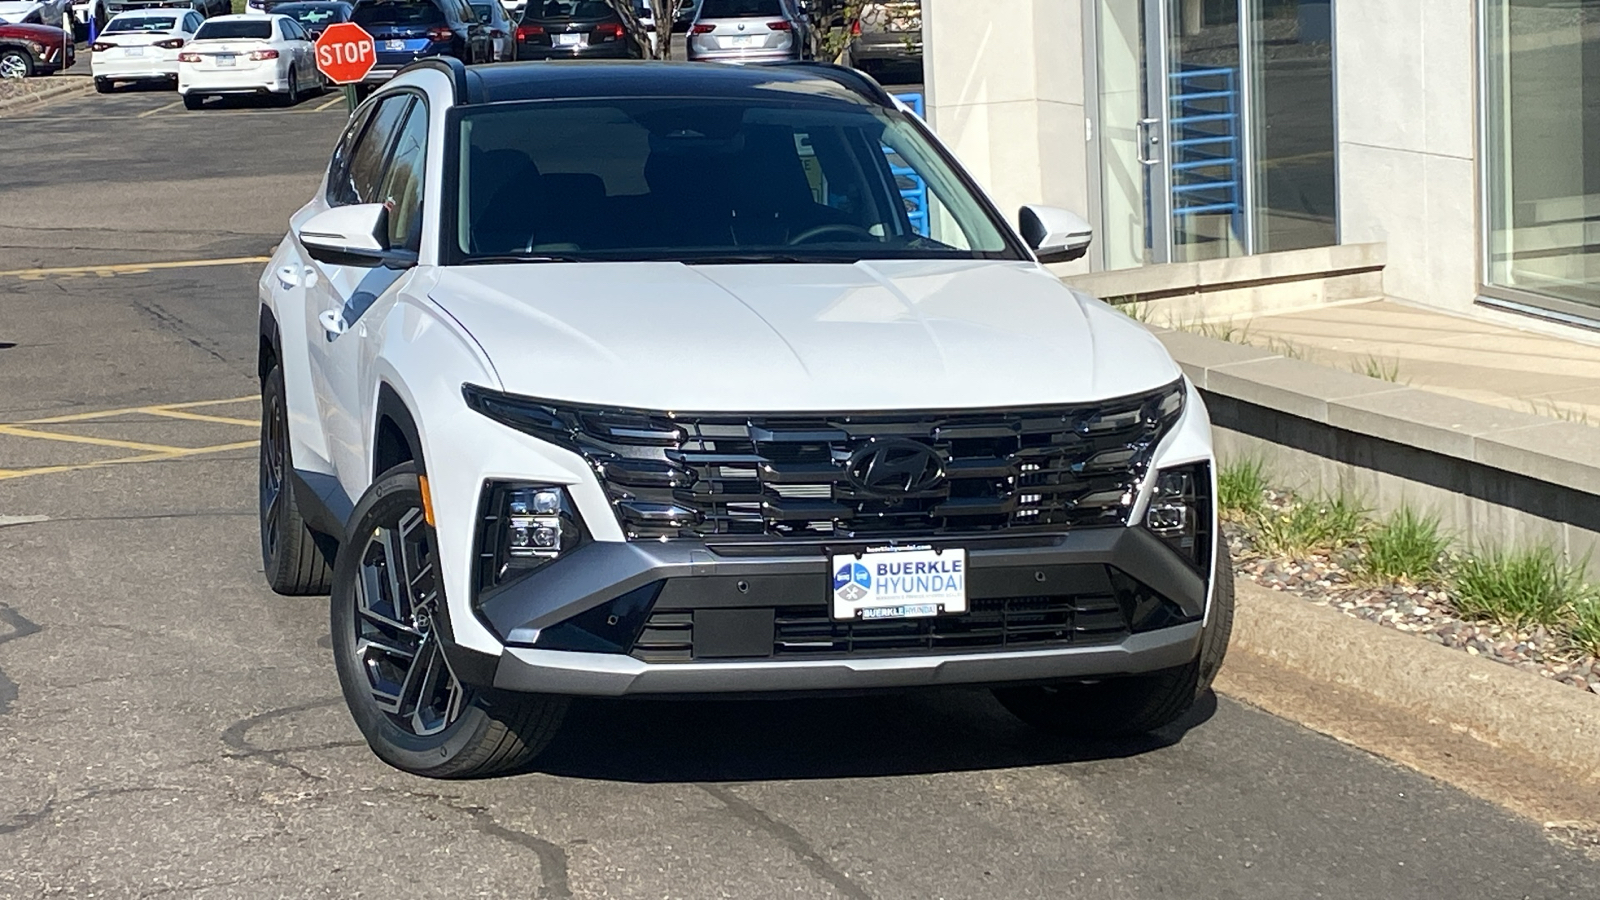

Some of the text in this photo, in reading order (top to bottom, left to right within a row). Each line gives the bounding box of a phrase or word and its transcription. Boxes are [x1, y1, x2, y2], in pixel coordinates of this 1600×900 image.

[319, 40, 371, 66] STOP
[876, 559, 962, 576] BUERKLE
[875, 573, 963, 595] HYUNDAI
[863, 605, 936, 618] BUERKLE HYUNDAI
